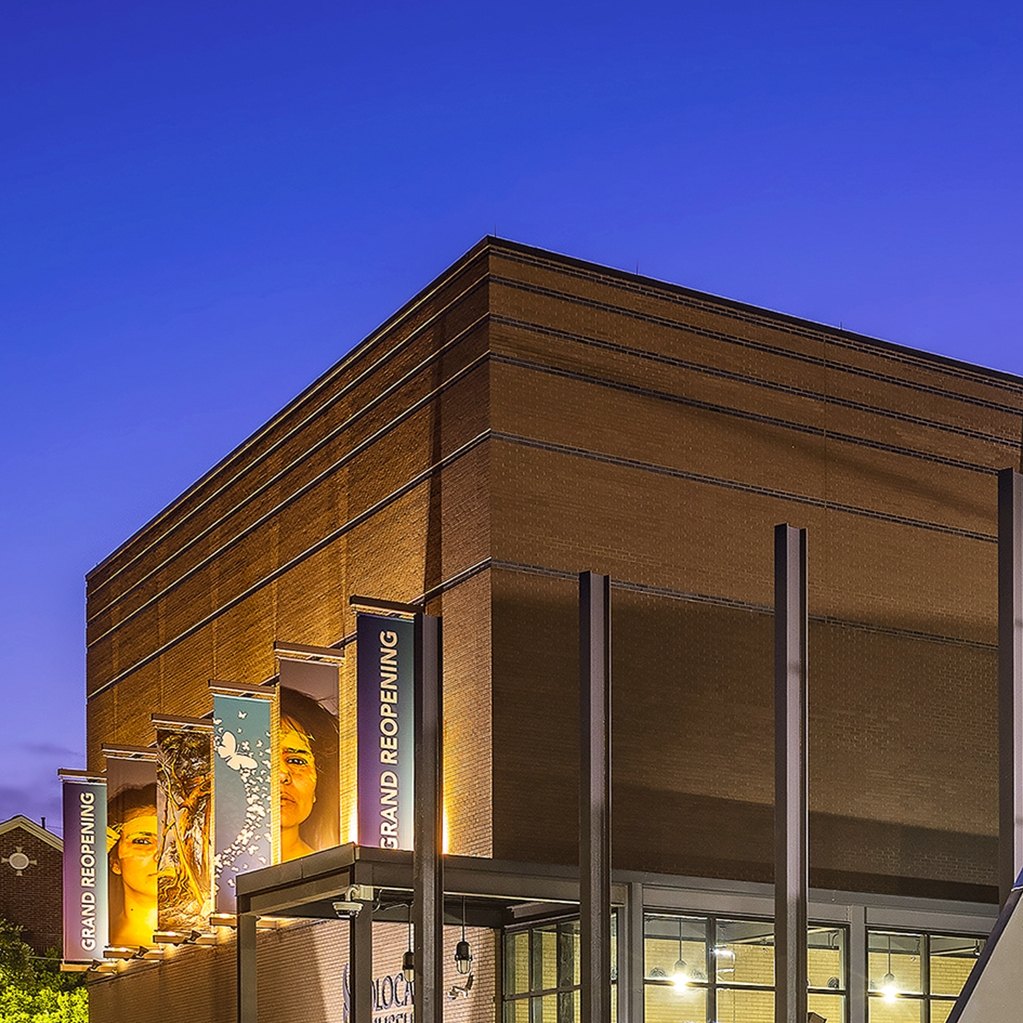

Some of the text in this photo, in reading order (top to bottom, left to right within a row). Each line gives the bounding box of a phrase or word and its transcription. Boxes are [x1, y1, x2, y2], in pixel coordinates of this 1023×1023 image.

[380, 630, 399, 849] GRAND REOPENING
[80, 792, 97, 951] GRAND REOPENING
